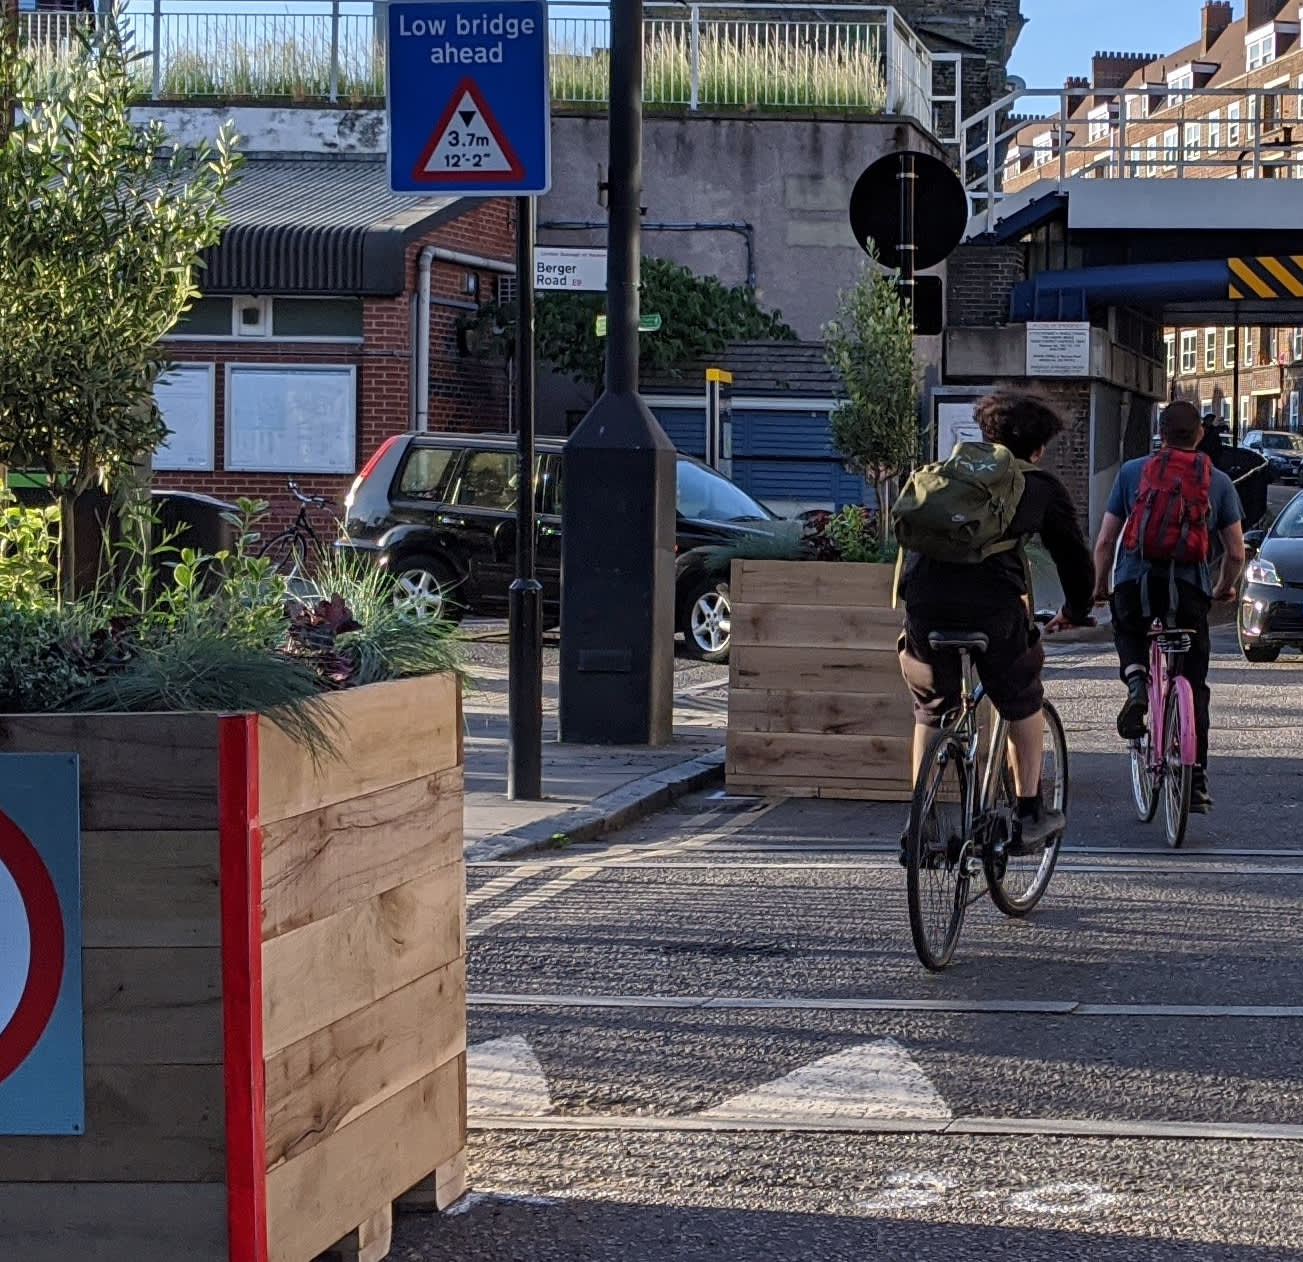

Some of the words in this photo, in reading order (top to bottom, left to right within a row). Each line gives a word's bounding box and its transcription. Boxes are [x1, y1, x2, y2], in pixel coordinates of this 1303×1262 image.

[400, 14, 446, 36] Low
[456, 13, 535, 39] bridge
[430, 41, 503, 64] ahead
[447, 130, 489, 147] 3.7m
[536, 262, 576, 275] Berger
[536, 275, 567, 286] Road
